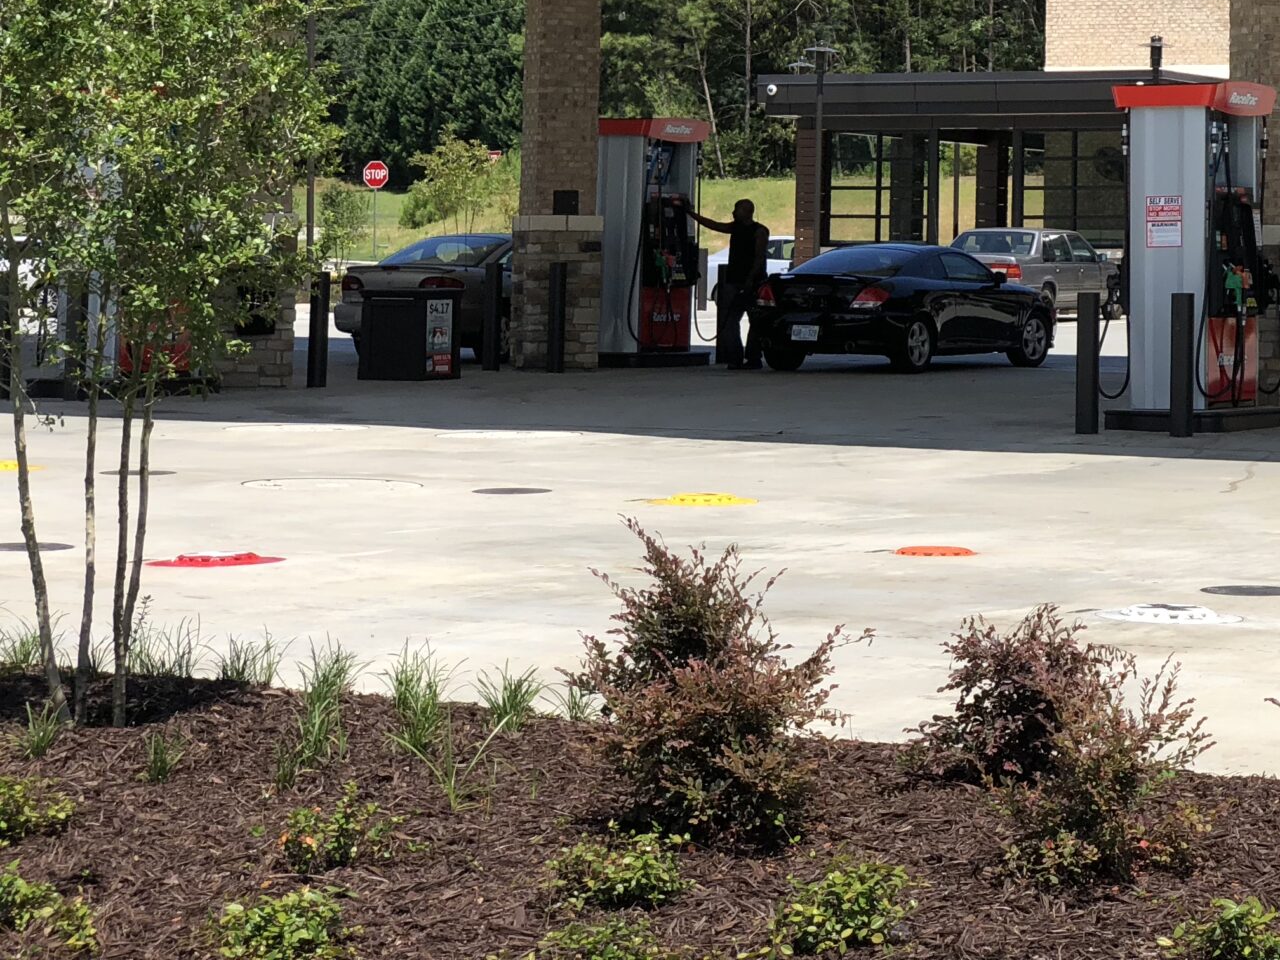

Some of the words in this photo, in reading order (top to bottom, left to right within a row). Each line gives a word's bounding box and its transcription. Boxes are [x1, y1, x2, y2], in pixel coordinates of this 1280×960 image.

[1229, 92, 1259, 106] RaceTrac
[365, 169, 387, 180] STOP
[1149, 197, 1162, 205] SELF
[1163, 197, 1180, 205] SERVE
[429, 302, 450, 315] $4.17
